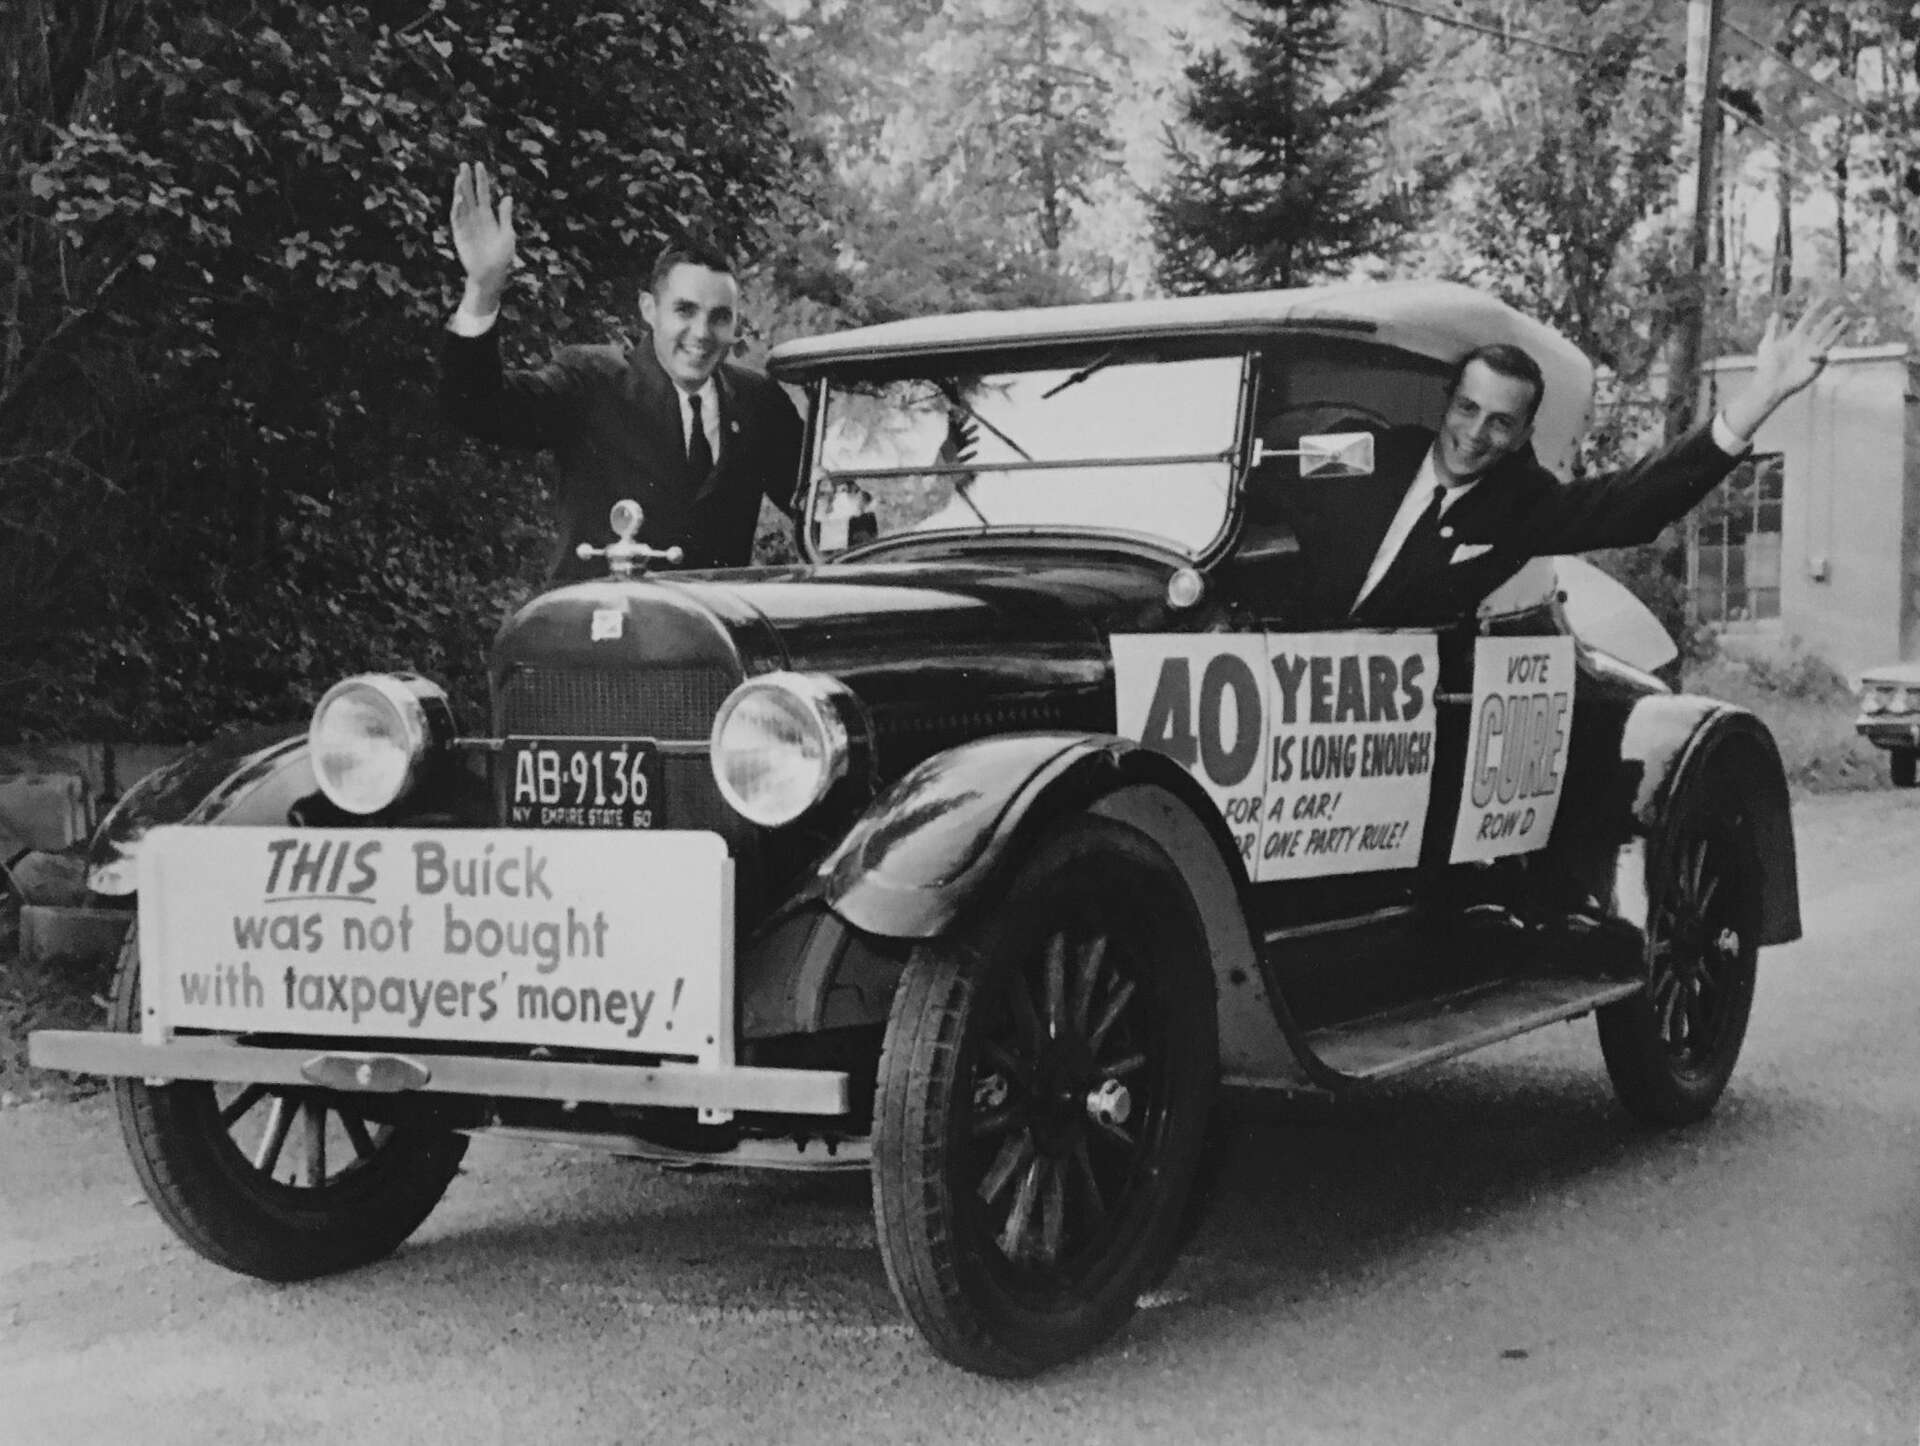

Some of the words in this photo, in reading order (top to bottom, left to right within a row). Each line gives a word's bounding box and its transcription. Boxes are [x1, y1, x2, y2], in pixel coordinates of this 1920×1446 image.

[1507, 655, 1550, 684] VOTE
[1141, 653, 1262, 787] 40
[1271, 653, 1424, 724] YEARS
[1271, 734, 1296, 782] IS
[1300, 733, 1356, 781] LONG
[1360, 731, 1431, 778] ENOUGH
[513, 807, 532, 822] NY
[541, 807, 584, 826] EMPIRE
[588, 808, 624, 827] STATE
[1268, 797, 1285, 823] A
[1292, 791, 1342, 821] CAR!
[1476, 812, 1521, 841] ROW
[1519, 807, 1536, 835] D
[1264, 829, 1304, 860] ONE
[1304, 824, 1358, 852] PARTY
[1357, 820, 1409, 850] RULE!
[265, 839, 382, 895] THIS
[411, 840, 552, 901] Buick
[233, 912, 324, 954] was
[342, 905, 413, 952] not
[443, 904, 609, 975] bought
[180, 962, 265, 1009] with
